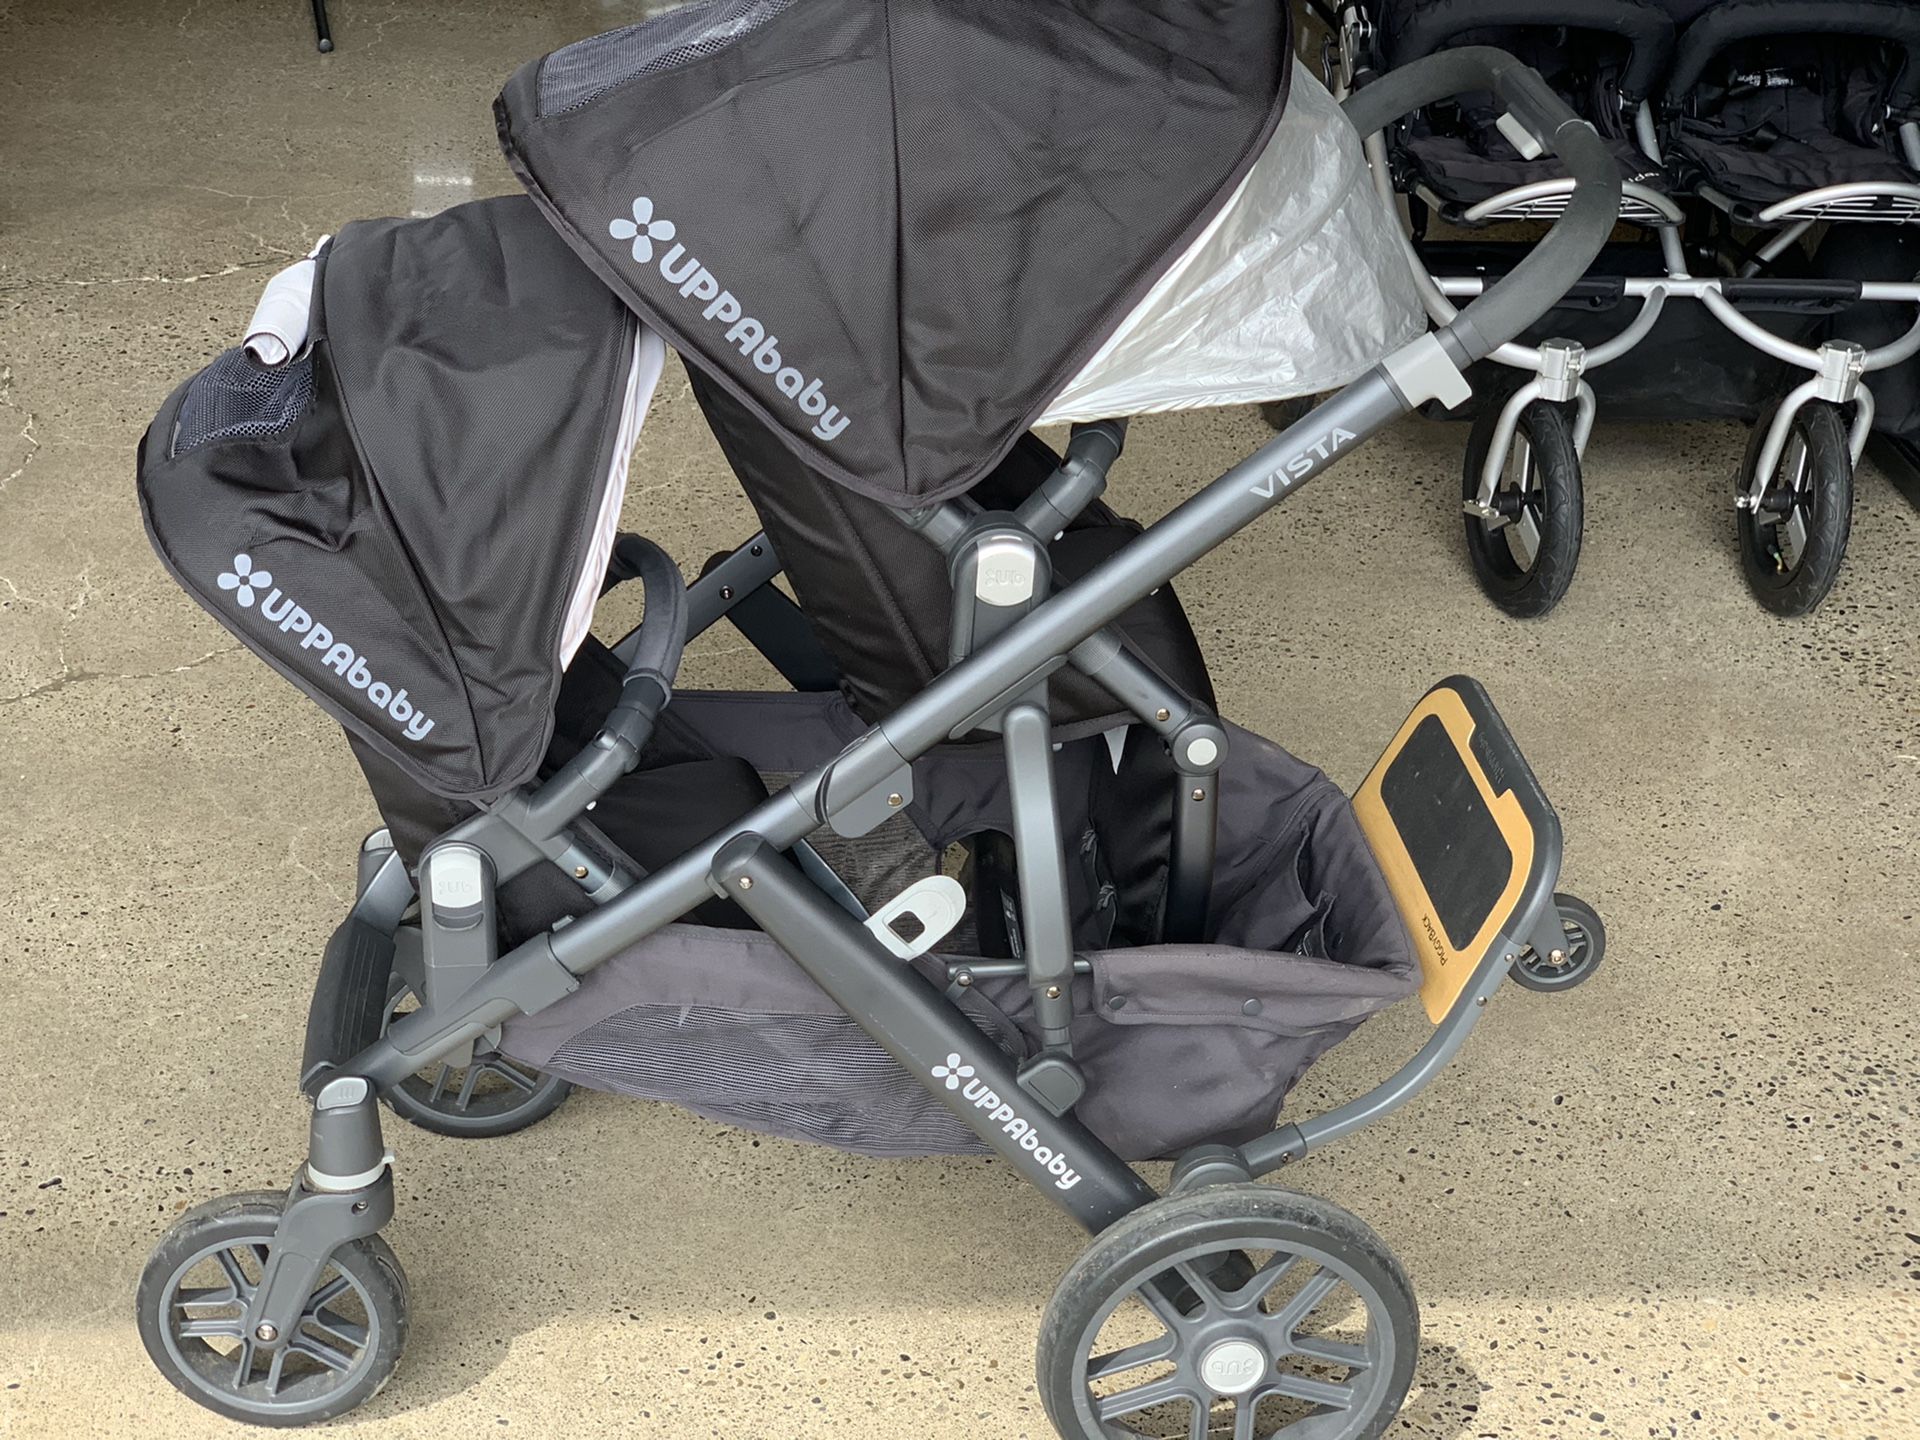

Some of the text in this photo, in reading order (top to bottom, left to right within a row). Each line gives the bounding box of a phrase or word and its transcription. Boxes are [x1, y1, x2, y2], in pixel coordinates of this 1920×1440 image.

[659, 242, 851, 442] UPPAbaby
[1249, 427, 1357, 498] VISTA
[261, 587, 436, 741] UPPAbaby
[1421, 912, 1449, 967] PIGGYBACK
[962, 1077, 1082, 1190] UPPAbaby
